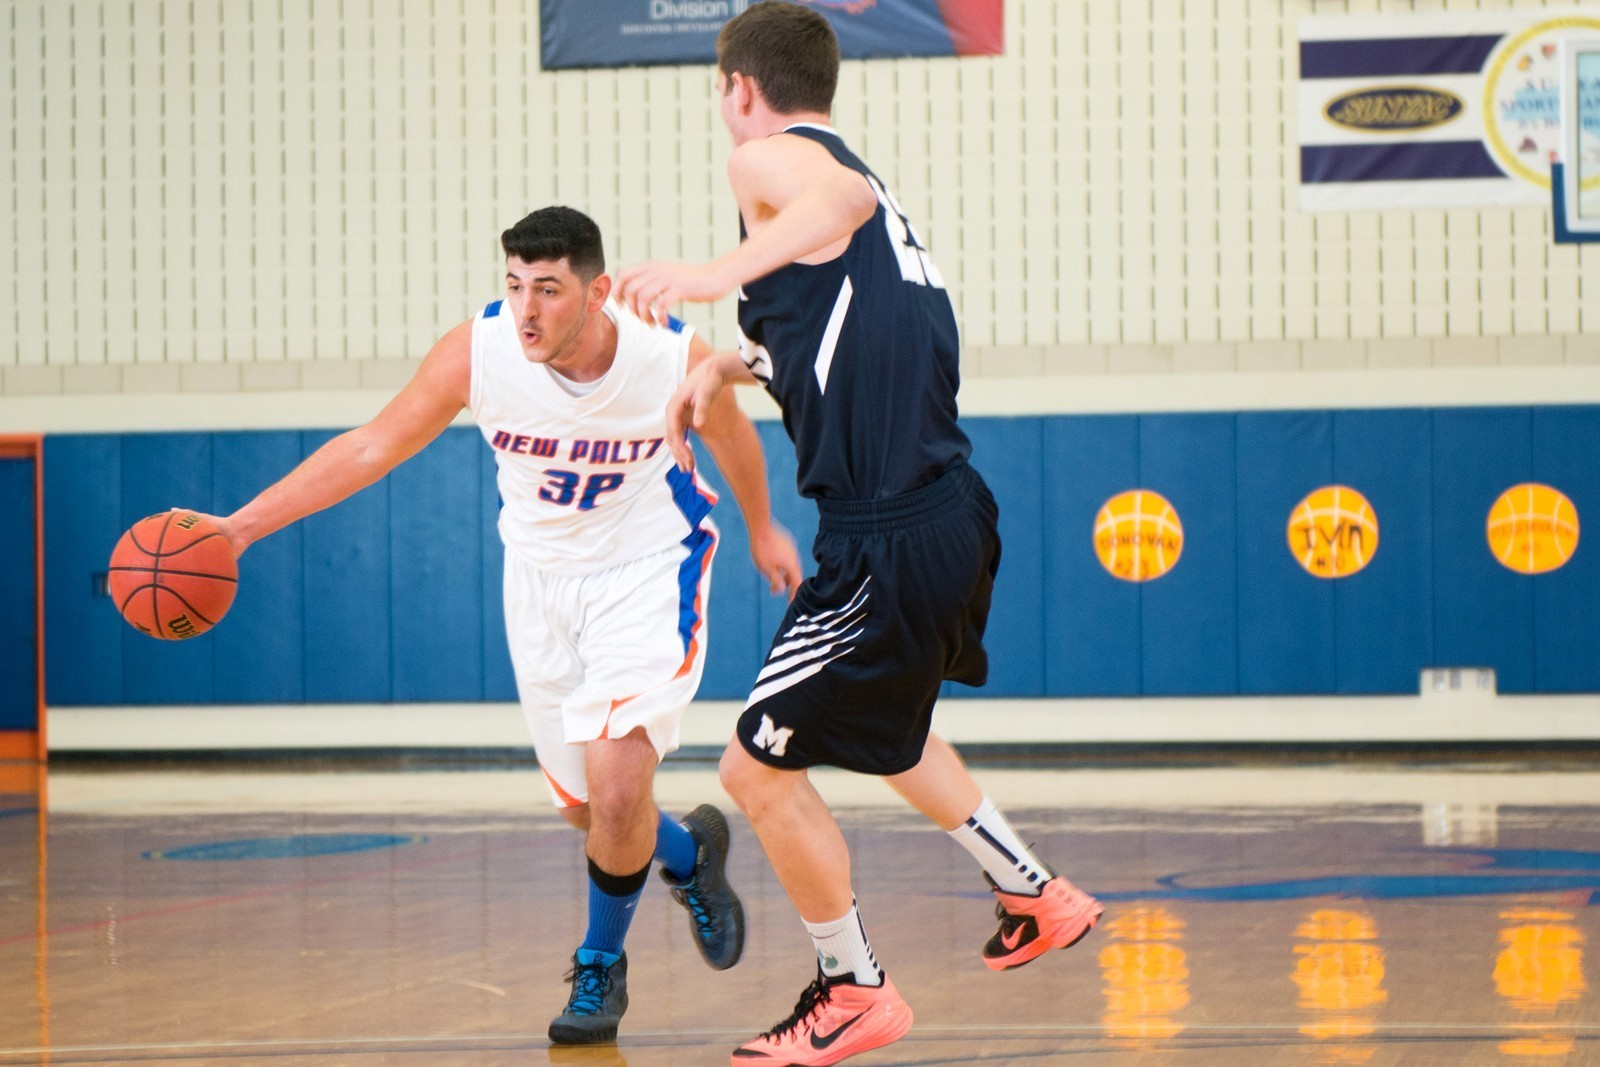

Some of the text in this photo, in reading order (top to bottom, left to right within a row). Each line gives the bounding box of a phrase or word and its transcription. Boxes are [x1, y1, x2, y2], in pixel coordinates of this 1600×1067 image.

[650, 0, 728, 20] Division
[491, 430, 560, 458] NEW
[752, 713, 795, 757] M
